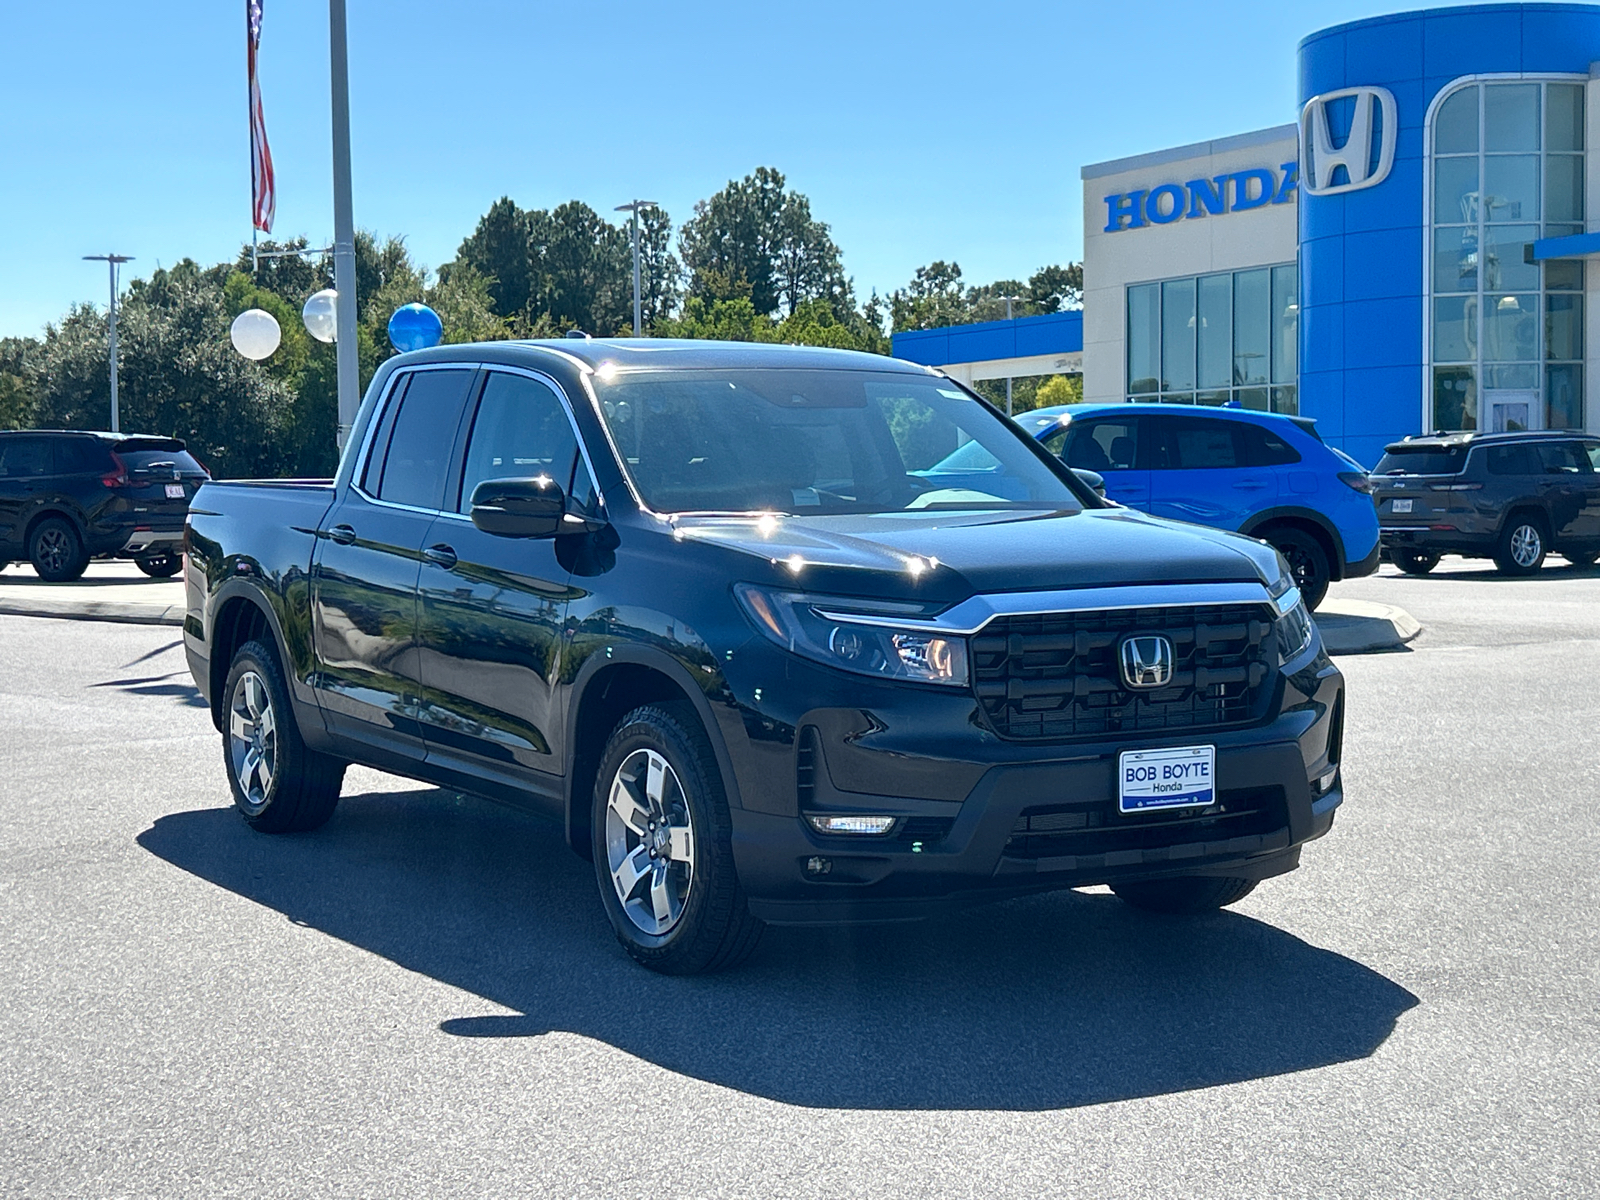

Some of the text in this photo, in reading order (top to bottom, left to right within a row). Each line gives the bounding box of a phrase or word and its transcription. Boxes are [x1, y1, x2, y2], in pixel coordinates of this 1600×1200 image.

[1103, 161, 1297, 233] HONDA
[1126, 762, 1209, 782] BOB BOYTE
[1152, 781, 1182, 793] Honda
